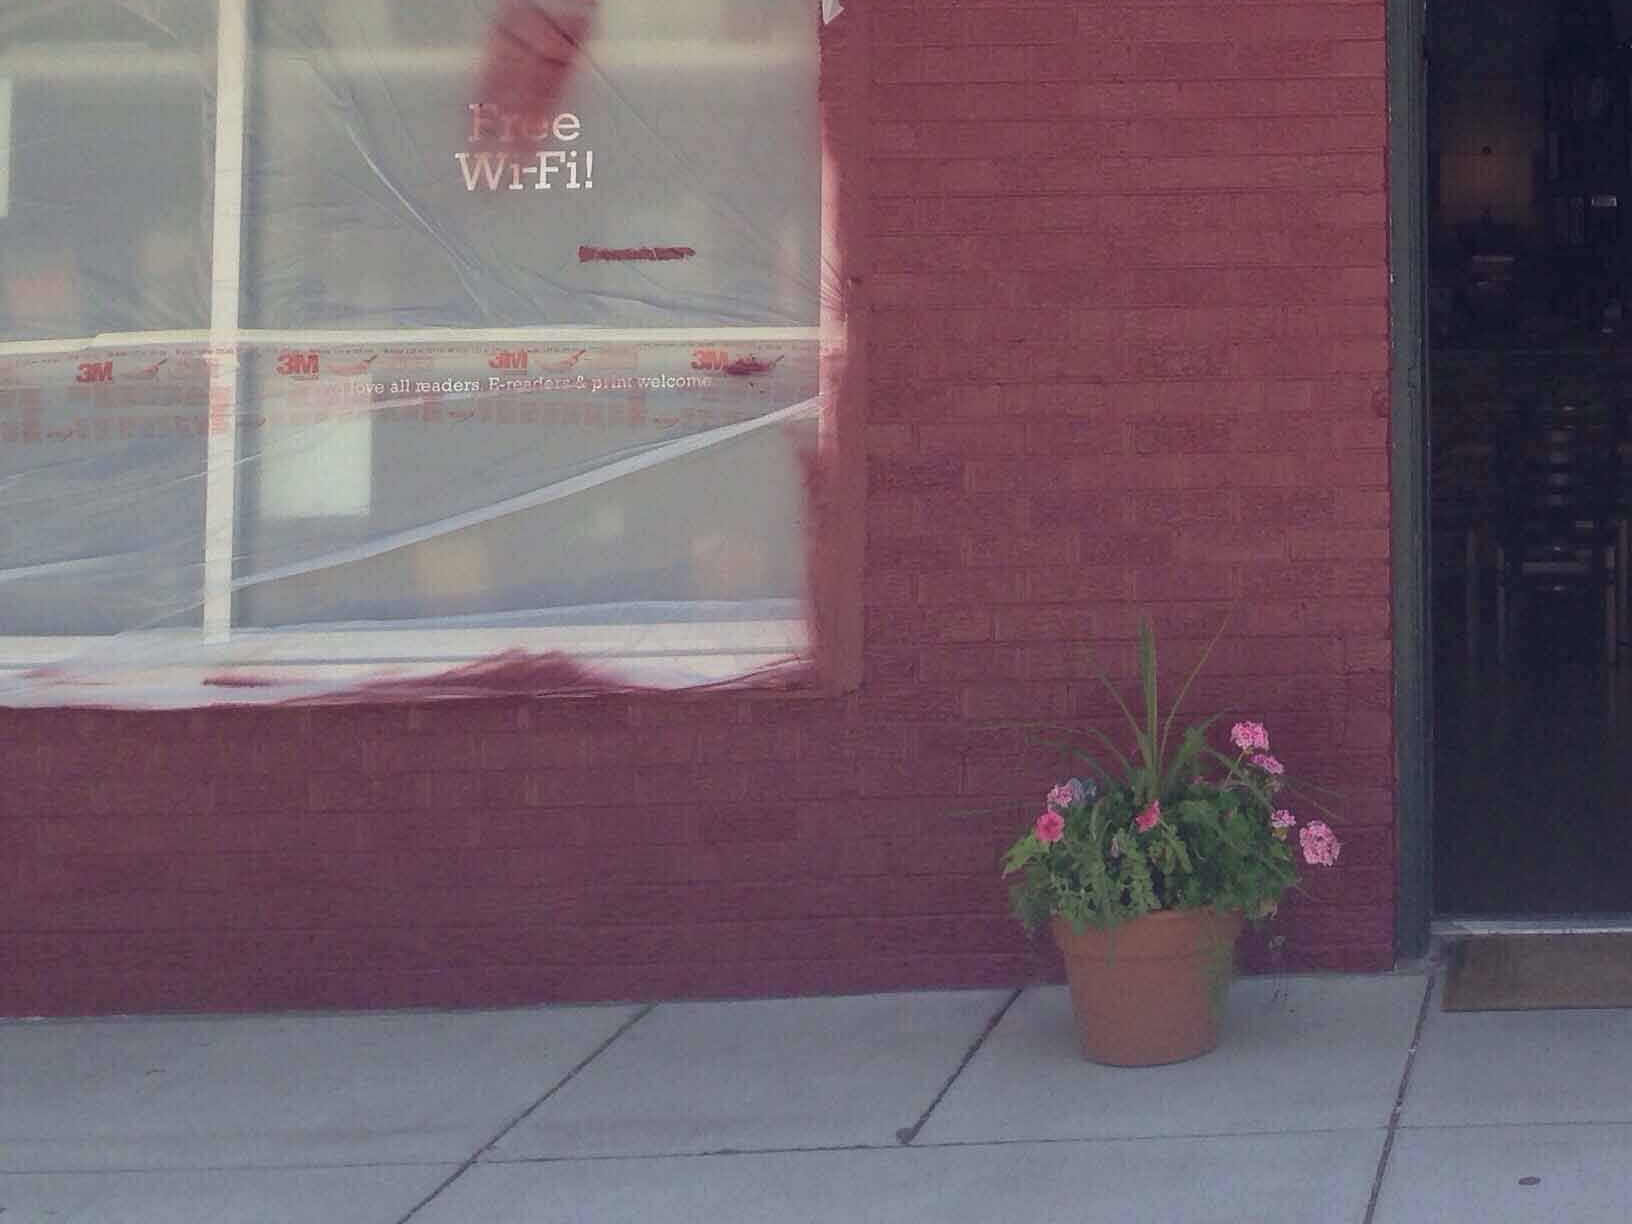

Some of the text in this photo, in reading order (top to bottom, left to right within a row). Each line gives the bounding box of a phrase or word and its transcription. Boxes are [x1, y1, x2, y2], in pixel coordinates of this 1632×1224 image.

[468, 103, 581, 142] Free
[454, 150, 593, 192] Wi-Fi!
[76, 360, 113, 383] 3M
[276, 350, 320, 376] 3M
[351, 380, 384, 394] love
[390, 378, 410, 393] all
[575, 375, 586, 390] &
[591, 375, 633, 393] print
[639, 373, 712, 390] welcome
